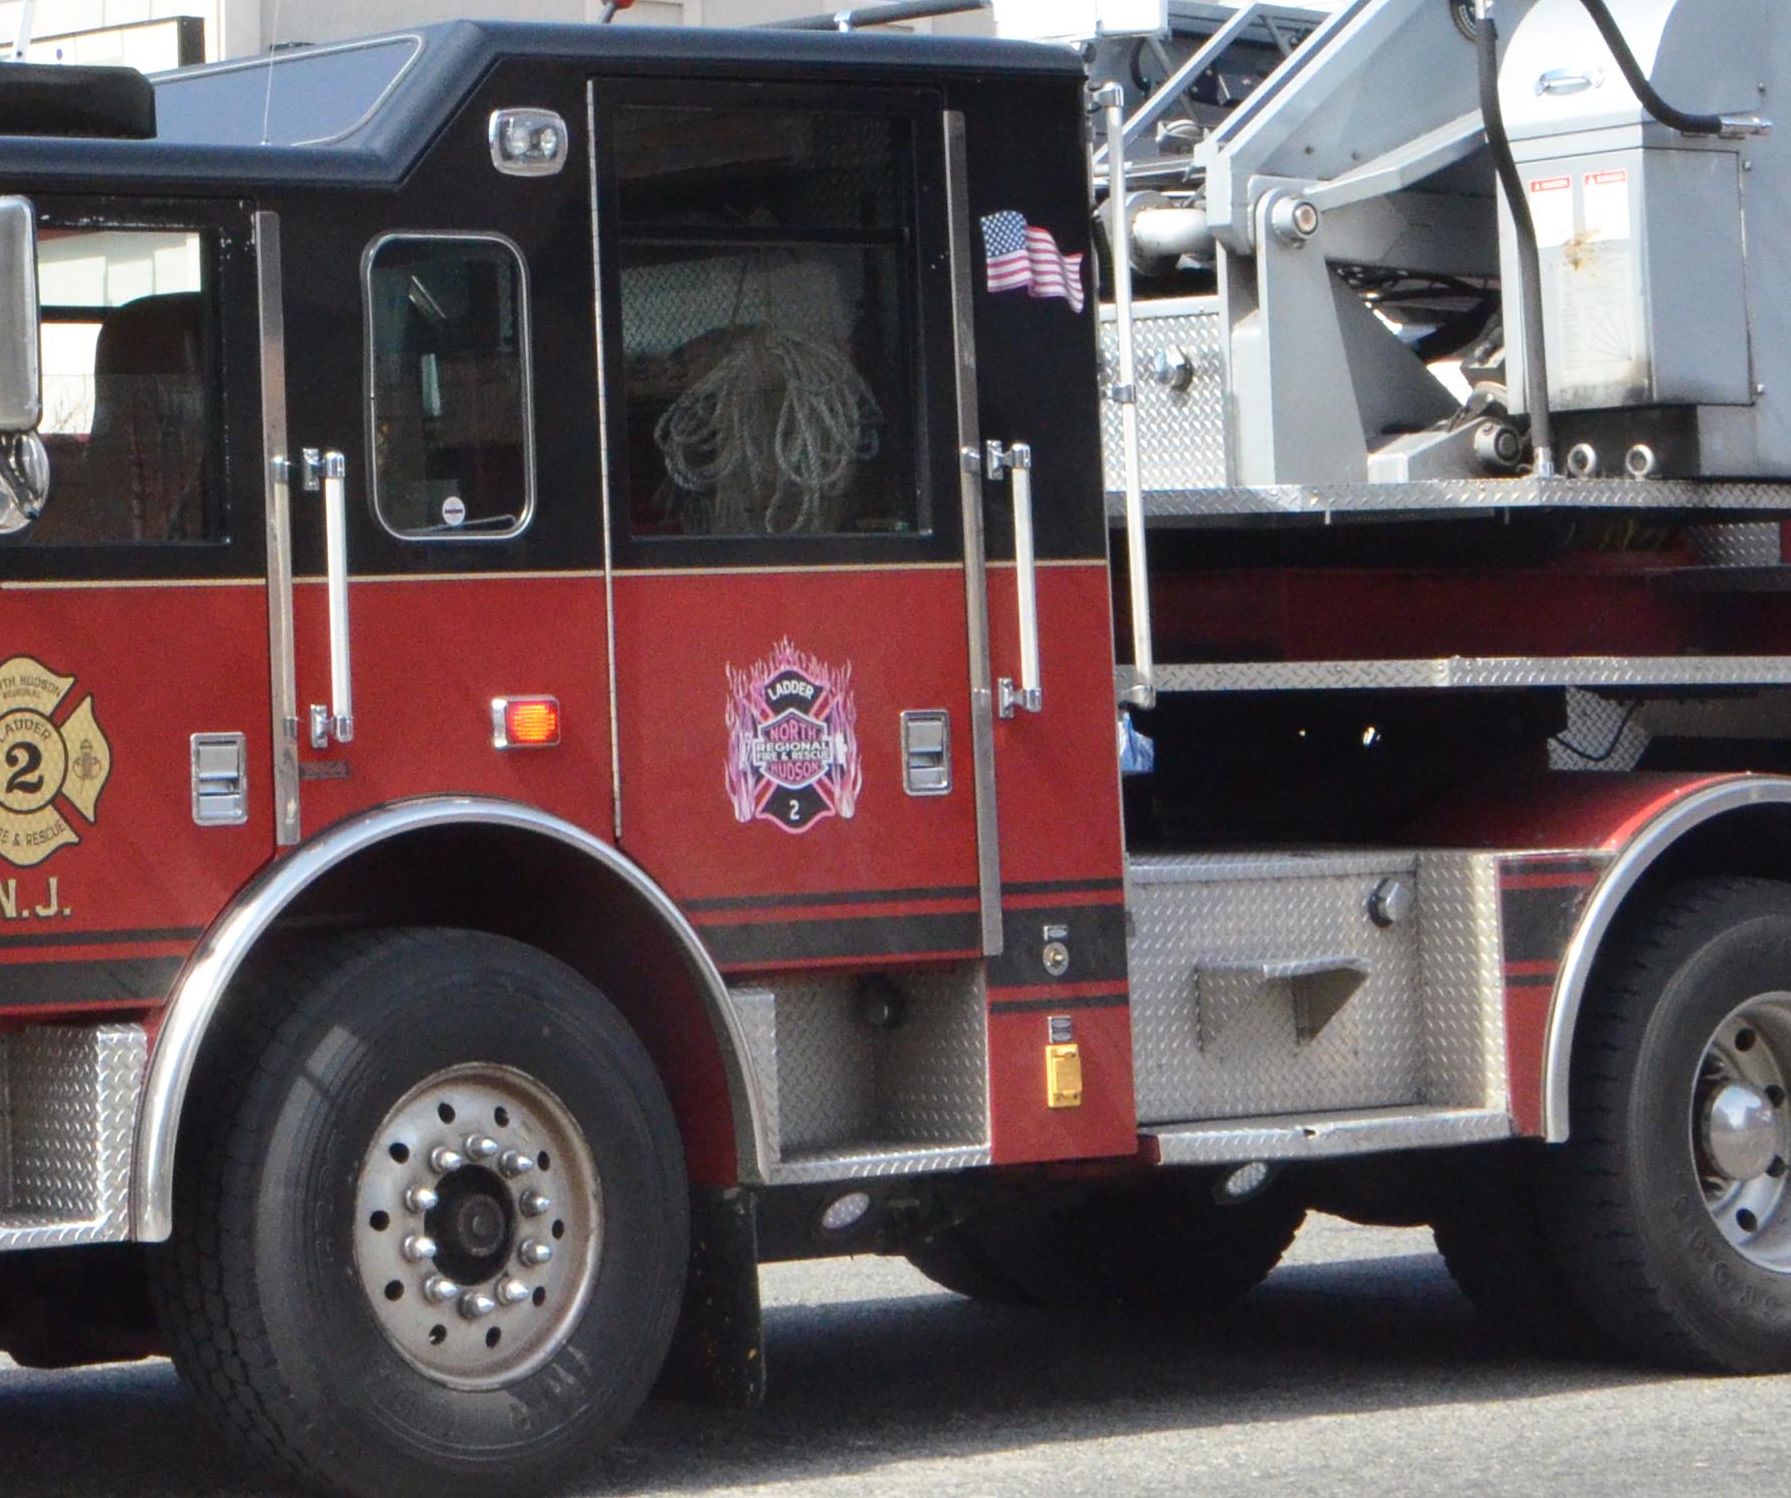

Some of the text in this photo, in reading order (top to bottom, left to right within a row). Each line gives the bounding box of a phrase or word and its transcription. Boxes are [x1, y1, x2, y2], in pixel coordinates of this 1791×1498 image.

[19, 675, 59, 698] HUDSON
[768, 680, 815, 701] LADDER
[770, 719, 816, 741] NORTH
[756, 742, 829, 752] REGIONAL
[5, 741, 44, 794] 2
[770, 761, 819, 781] HUDSON
[789, 801, 800, 820] 2
[12, 835, 20, 847] &
[26, 820, 67, 846] RESCUE
